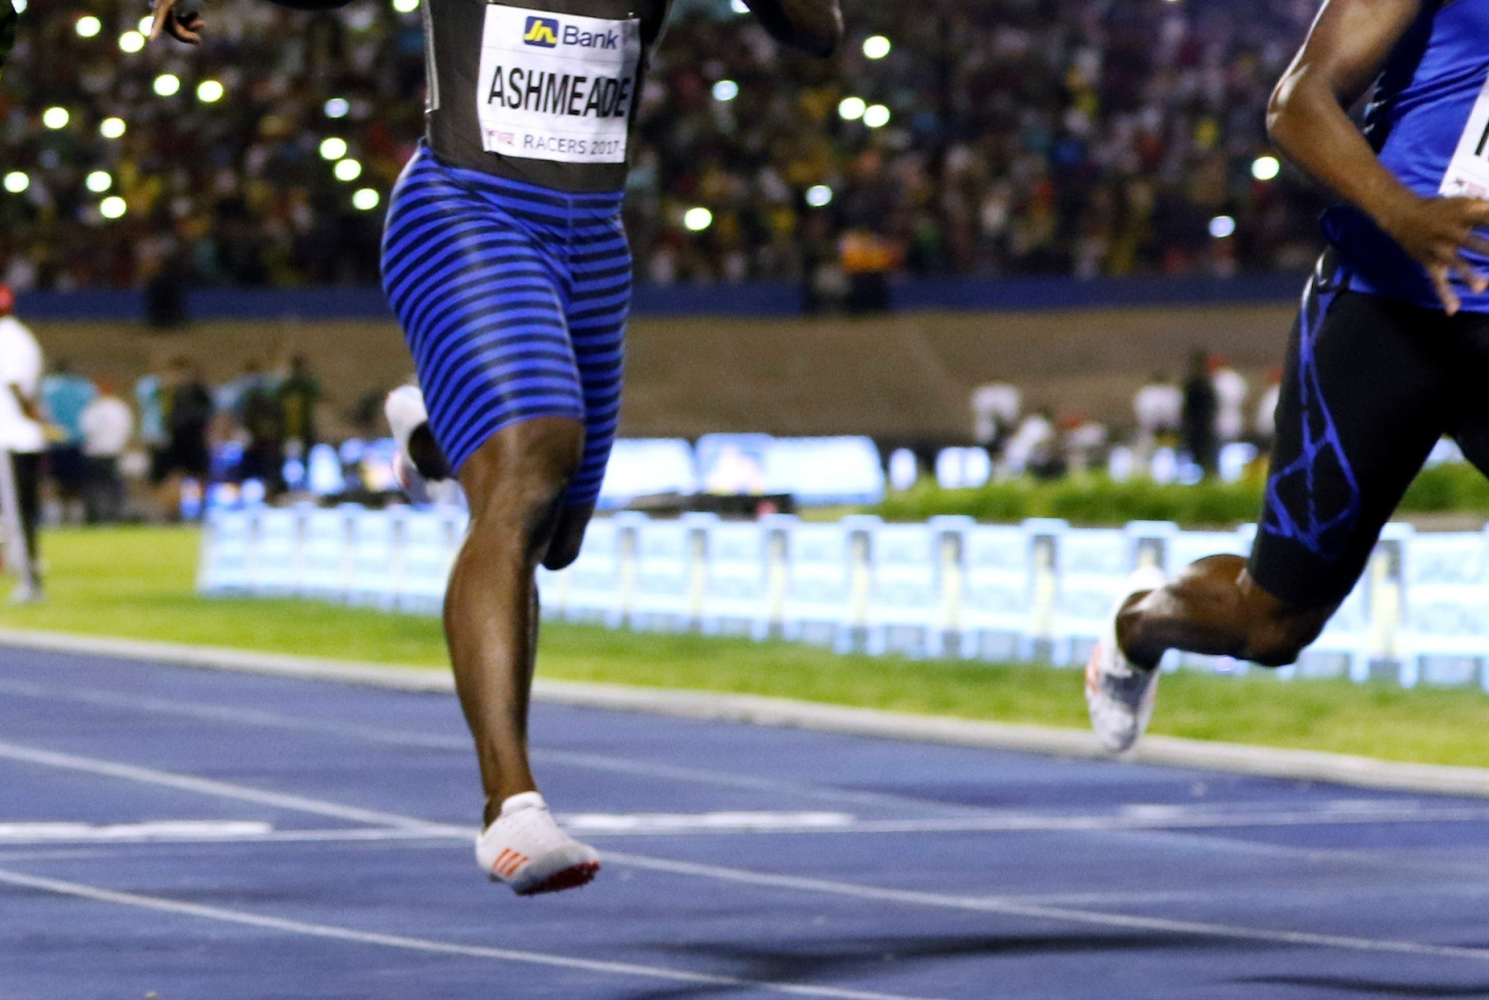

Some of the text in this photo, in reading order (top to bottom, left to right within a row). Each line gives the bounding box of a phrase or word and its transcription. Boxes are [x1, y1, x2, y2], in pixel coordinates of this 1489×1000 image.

[562, 24, 620, 50] Bank
[487, 65, 632, 118] ASHMEADE
[523, 134, 587, 155] RACERS
[590, 140, 620, 155] 2017
